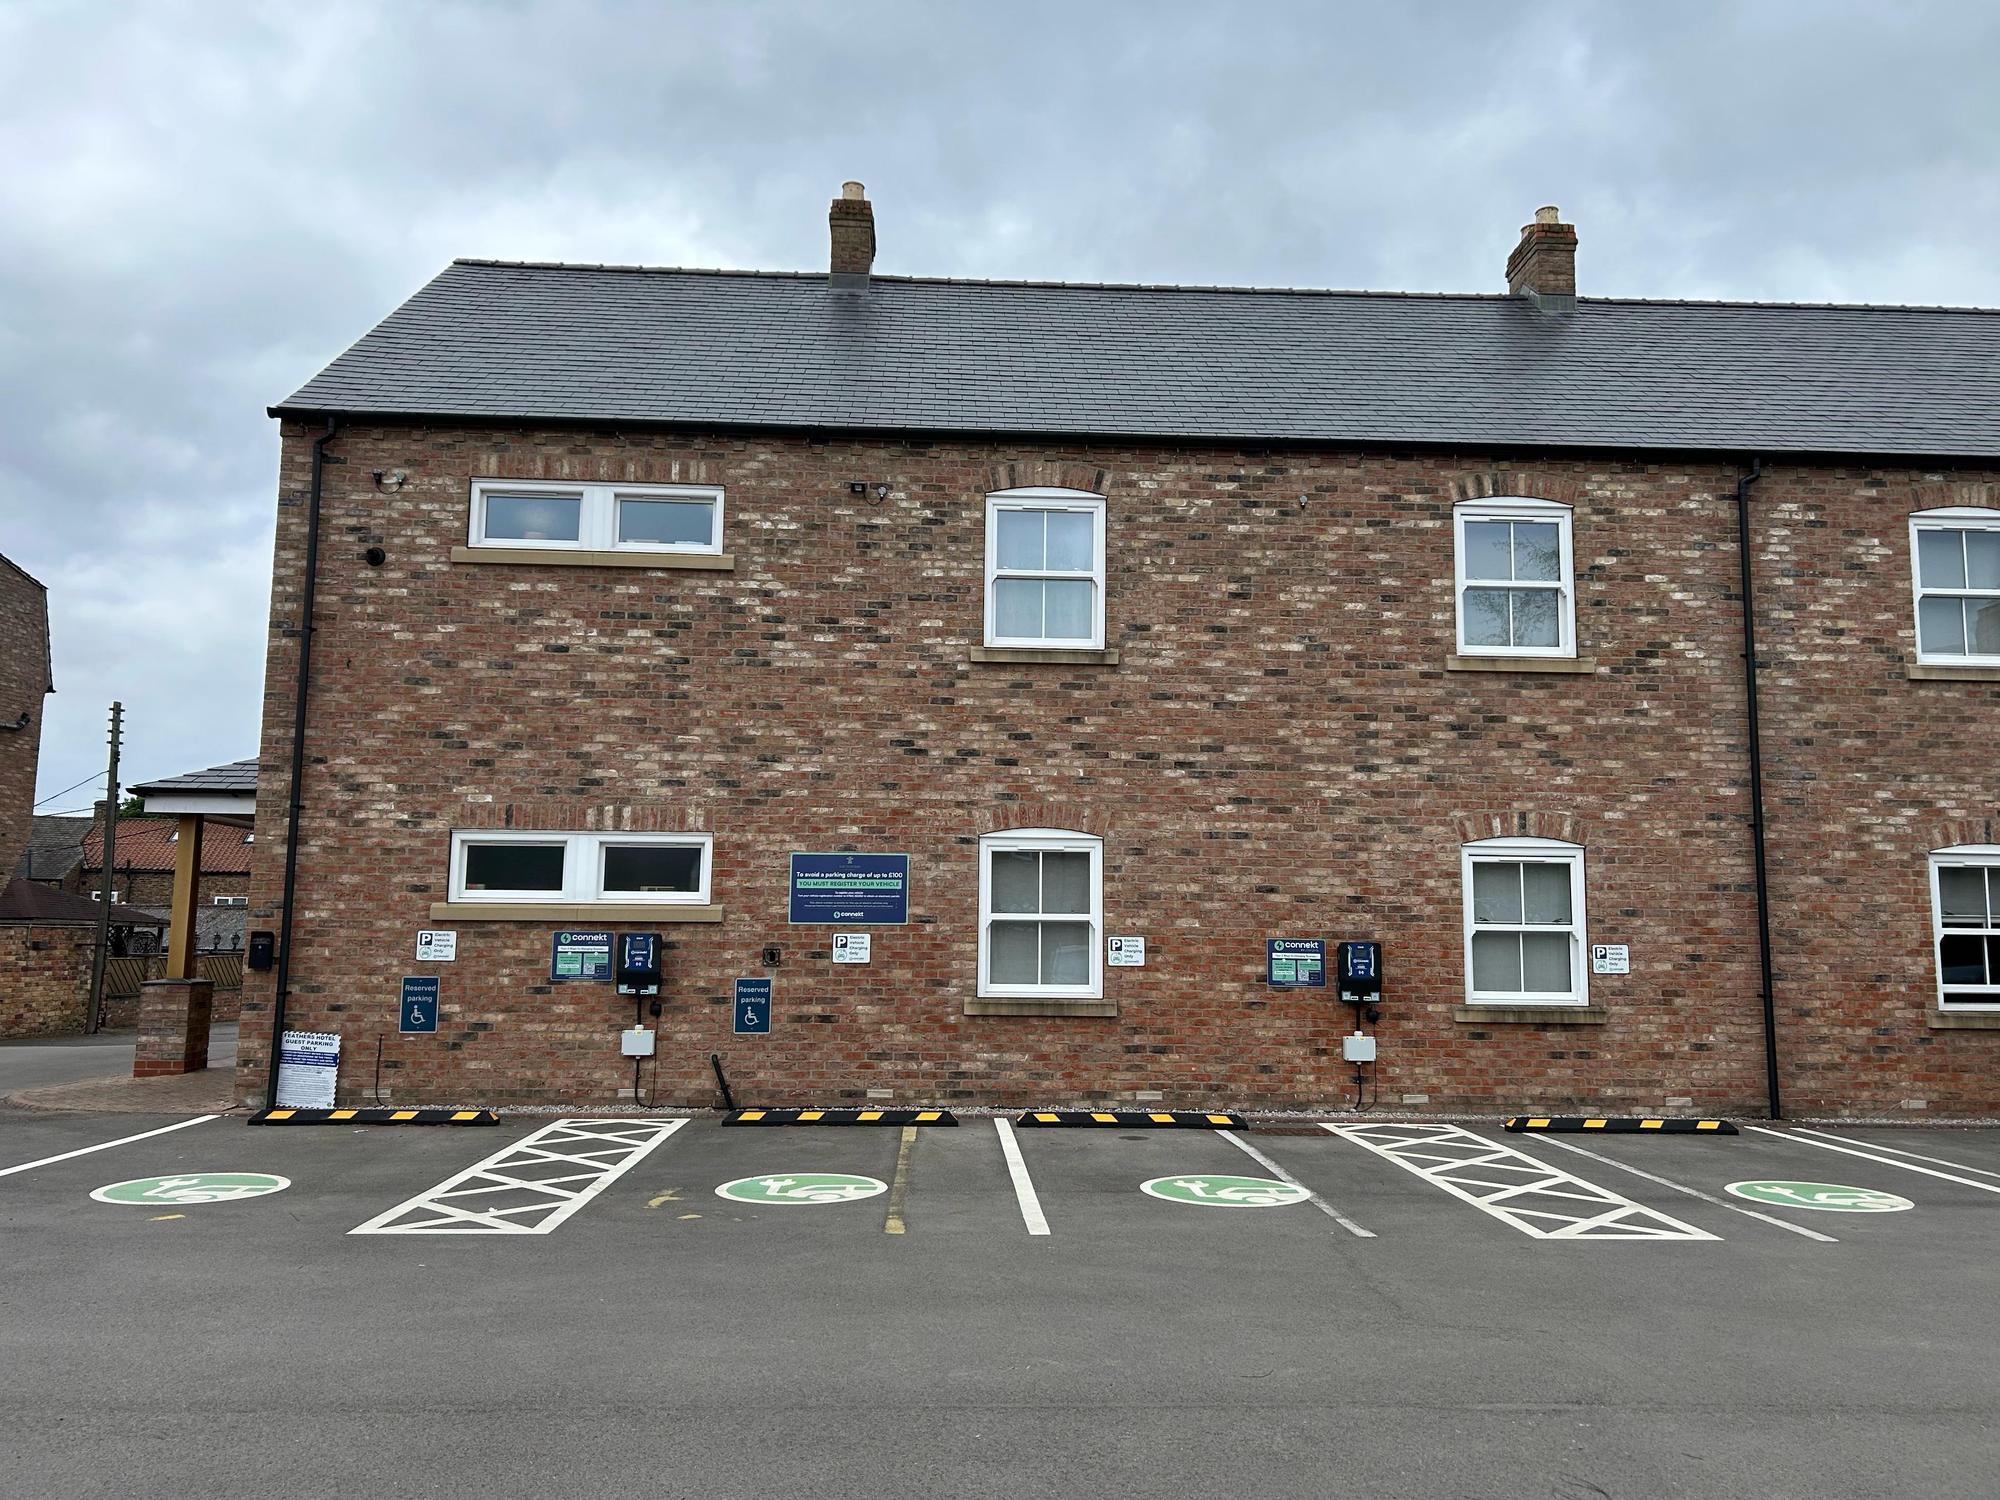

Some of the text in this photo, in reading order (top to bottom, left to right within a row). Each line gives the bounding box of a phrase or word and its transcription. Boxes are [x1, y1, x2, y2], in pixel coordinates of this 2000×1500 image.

[421, 934, 431, 945] P
[572, 933, 608, 941] connekt
[837, 937, 847, 948] P
[1112, 940, 1121, 951] P
[1284, 941, 1319, 949] connekt
[1596, 947, 1606, 958] P
[407, 995, 433, 1003] parking
[740, 996, 766, 1004] parking
